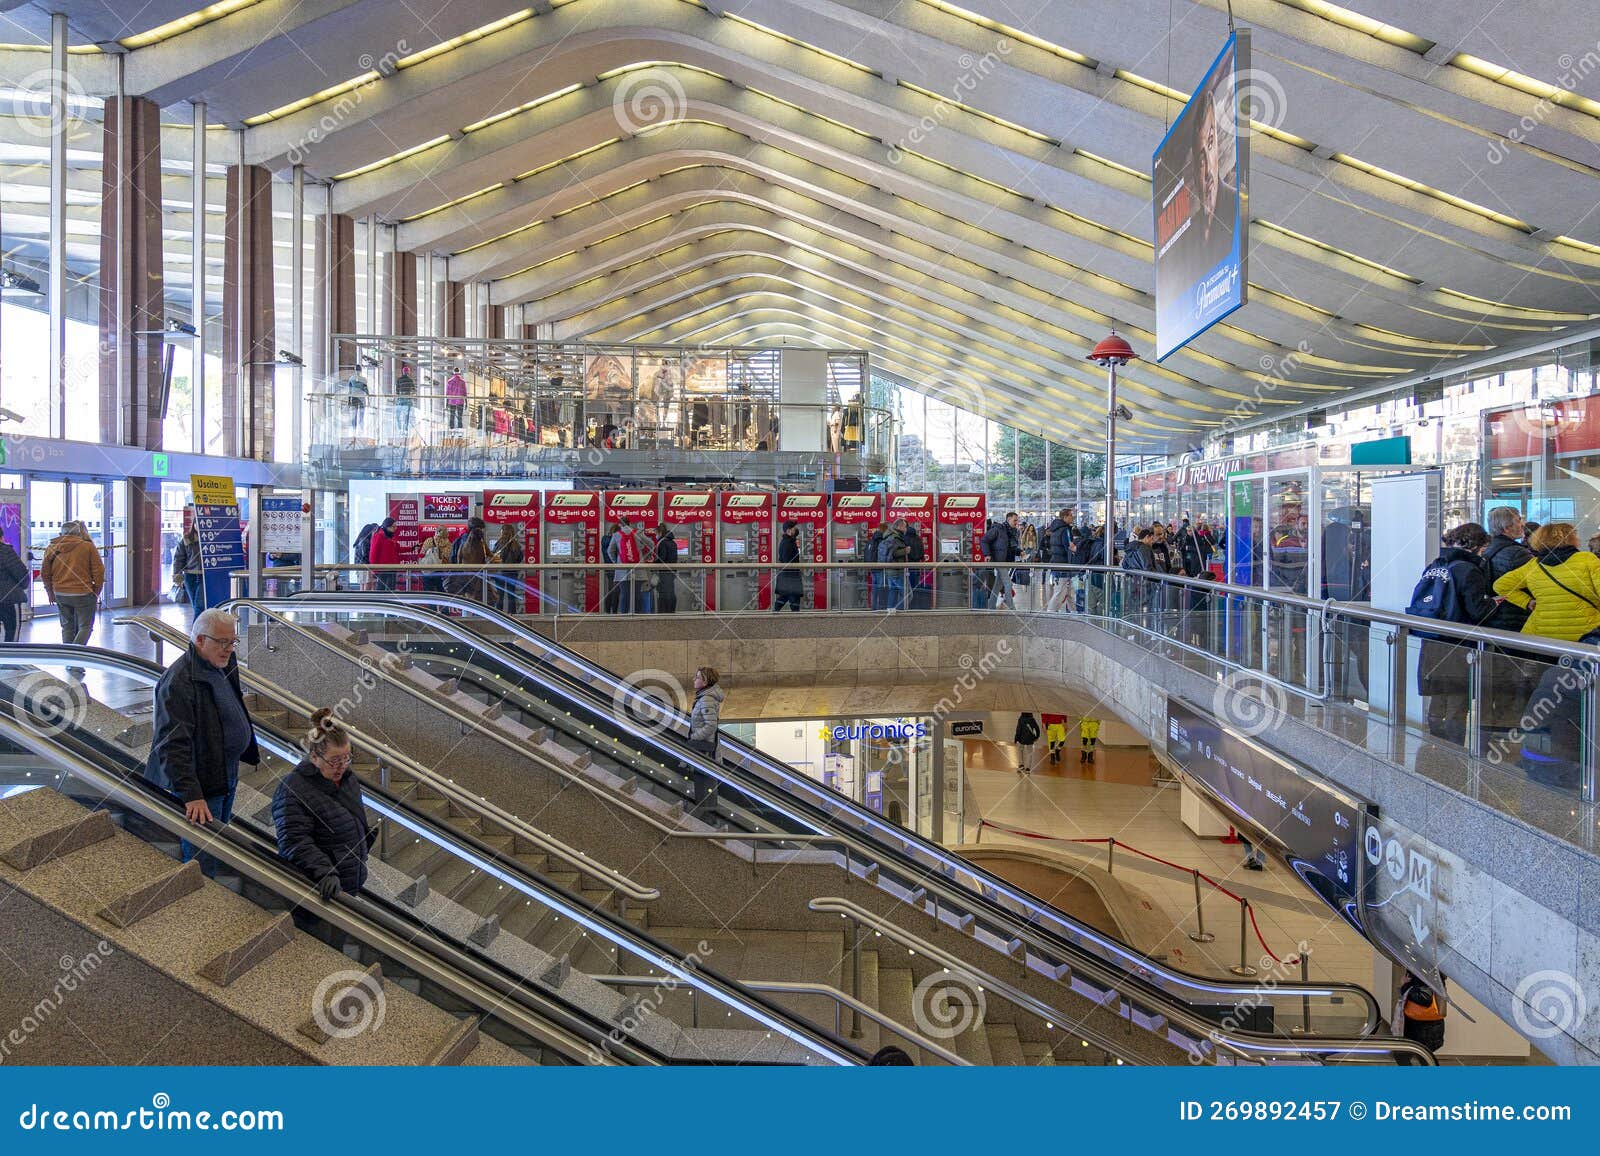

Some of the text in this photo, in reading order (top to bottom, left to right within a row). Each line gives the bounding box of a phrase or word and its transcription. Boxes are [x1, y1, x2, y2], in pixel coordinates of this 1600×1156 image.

[1190, 460, 1240, 485] TRENITALIA
[197, 479, 219, 489] Uscita
[431, 496, 462, 504] TICKETS
[833, 717, 926, 741] euronics
[954, 723, 982, 733] euronics
